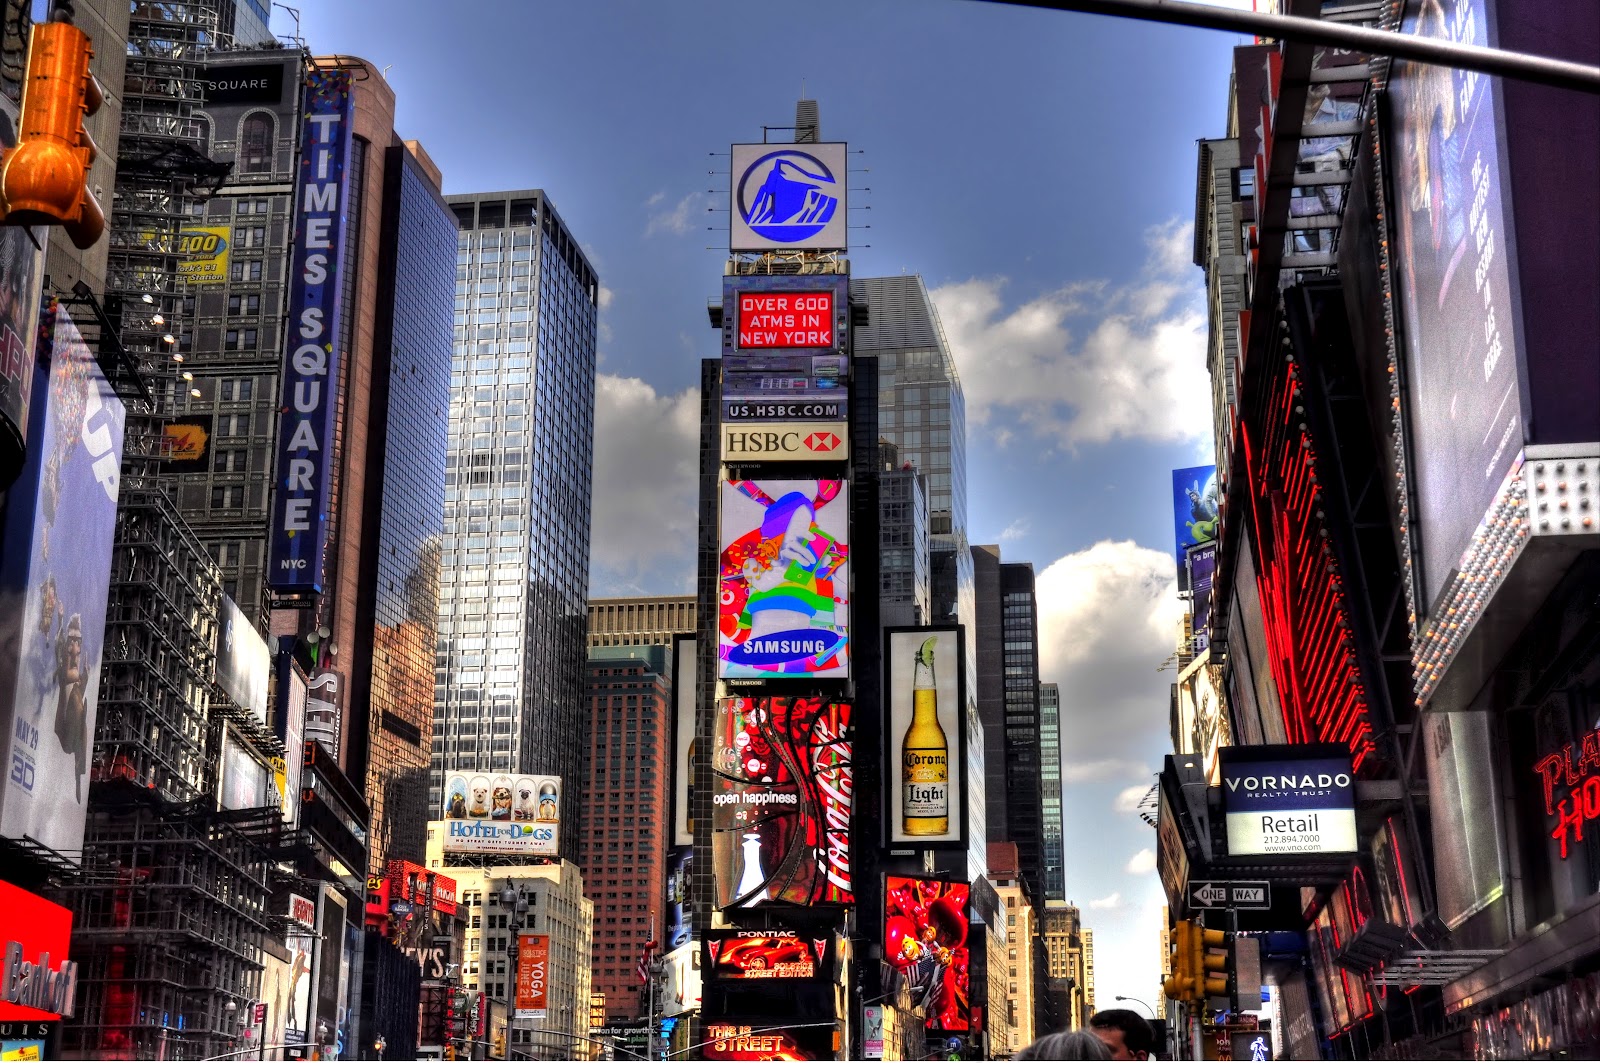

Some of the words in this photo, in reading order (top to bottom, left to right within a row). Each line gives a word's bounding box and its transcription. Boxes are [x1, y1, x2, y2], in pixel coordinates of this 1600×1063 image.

[208, 79, 268, 91] SQUARE
[303, 114, 341, 285] TIMES
[190, 273, 223, 281] Station
[742, 298, 788, 311] OVER
[794, 297, 829, 311] 600
[750, 315, 795, 328] ATMS
[802, 315, 820, 327] IN
[1485, 306, 1496, 345] LAS
[740, 331, 778, 345] NEW
[783, 330, 831, 344] YORK
[729, 404, 838, 417] US.HSBC.COM
[284, 307, 327, 531] SQUARE
[82, 377, 120, 503] UP
[727, 432, 800, 452] HSBC
[281, 559, 307, 569] NYC
[743, 640, 826, 654] SAMSUNG
[15, 716, 31, 745] MAY
[30, 727, 39, 750] 29
[332, 708, 341, 761] hocolate
[905, 753, 946, 768] Corona
[11, 754, 35, 791] 3D
[1533, 729, 1600, 815] PLA
[1225, 773, 1350, 793] VORNADO
[713, 793, 741, 807] open
[742, 790, 797, 805] happiness
[908, 784, 943, 803] Light
[450, 820, 500, 838] HOTEL
[1262, 813, 1319, 834] Retail
[1263, 834, 1320, 844] 212.894.7000
[1264, 843, 1322, 852] www.vno.com
[436, 887, 455, 902] PLAZA
[1201, 889, 1225, 900] ONE
[1235, 889, 1258, 900] WAY
[520, 961, 530, 986] JUNE
[744, 970, 777, 978] STREET
[778, 970, 814, 978] EDITION
[773, 962, 814, 970] SOLSTICE
[1, 940, 52, 1011] Bank
[50, 959, 78, 1019] of
[530, 961, 545, 998] YOGA
[519, 988, 529, 999] 21
[708, 1026, 737, 1038] THIS
[739, 1026, 752, 1037] IS
[714, 1036, 784, 1052] STREET
